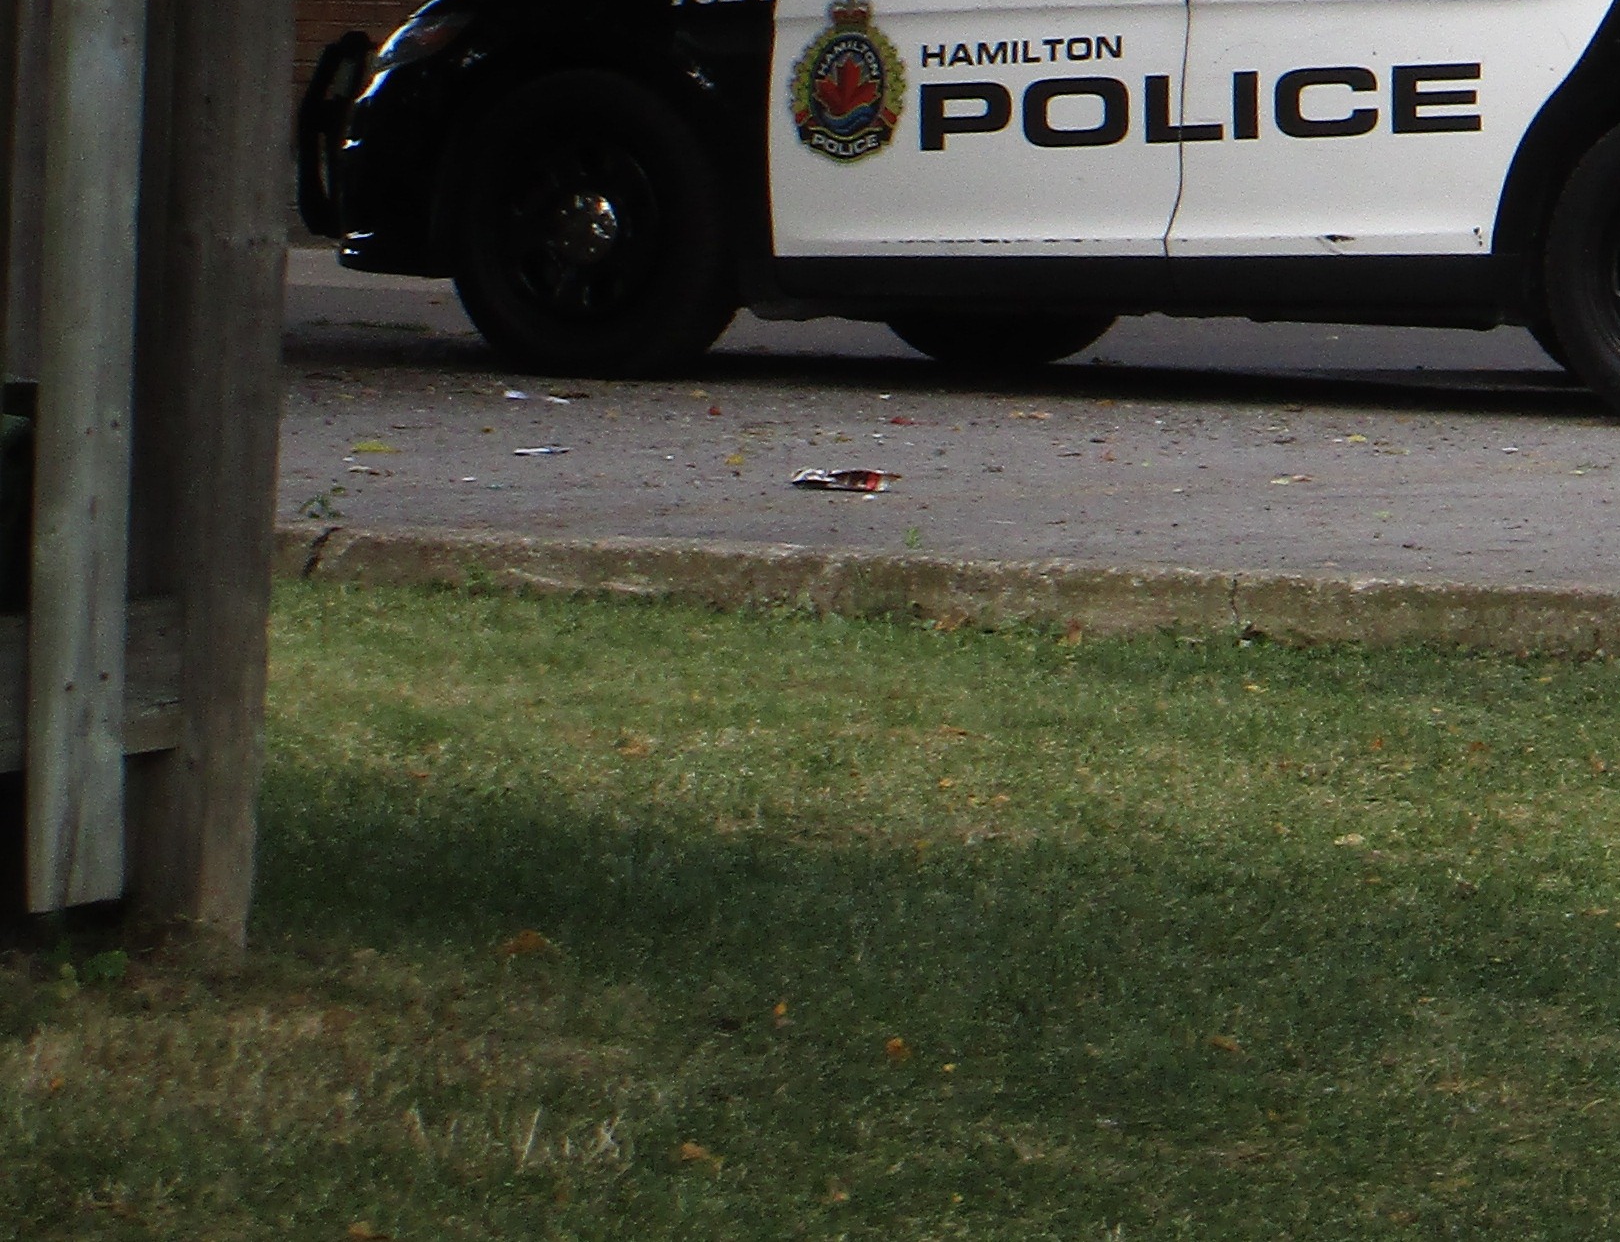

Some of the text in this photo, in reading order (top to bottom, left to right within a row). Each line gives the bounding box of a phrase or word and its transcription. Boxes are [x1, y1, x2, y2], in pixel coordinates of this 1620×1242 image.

[817, 39, 881, 77] HAMILTON
[921, 34, 1124, 69] HAMILTON
[919, 62, 1484, 152] POLICE
[811, 133, 880, 156] POLICE
